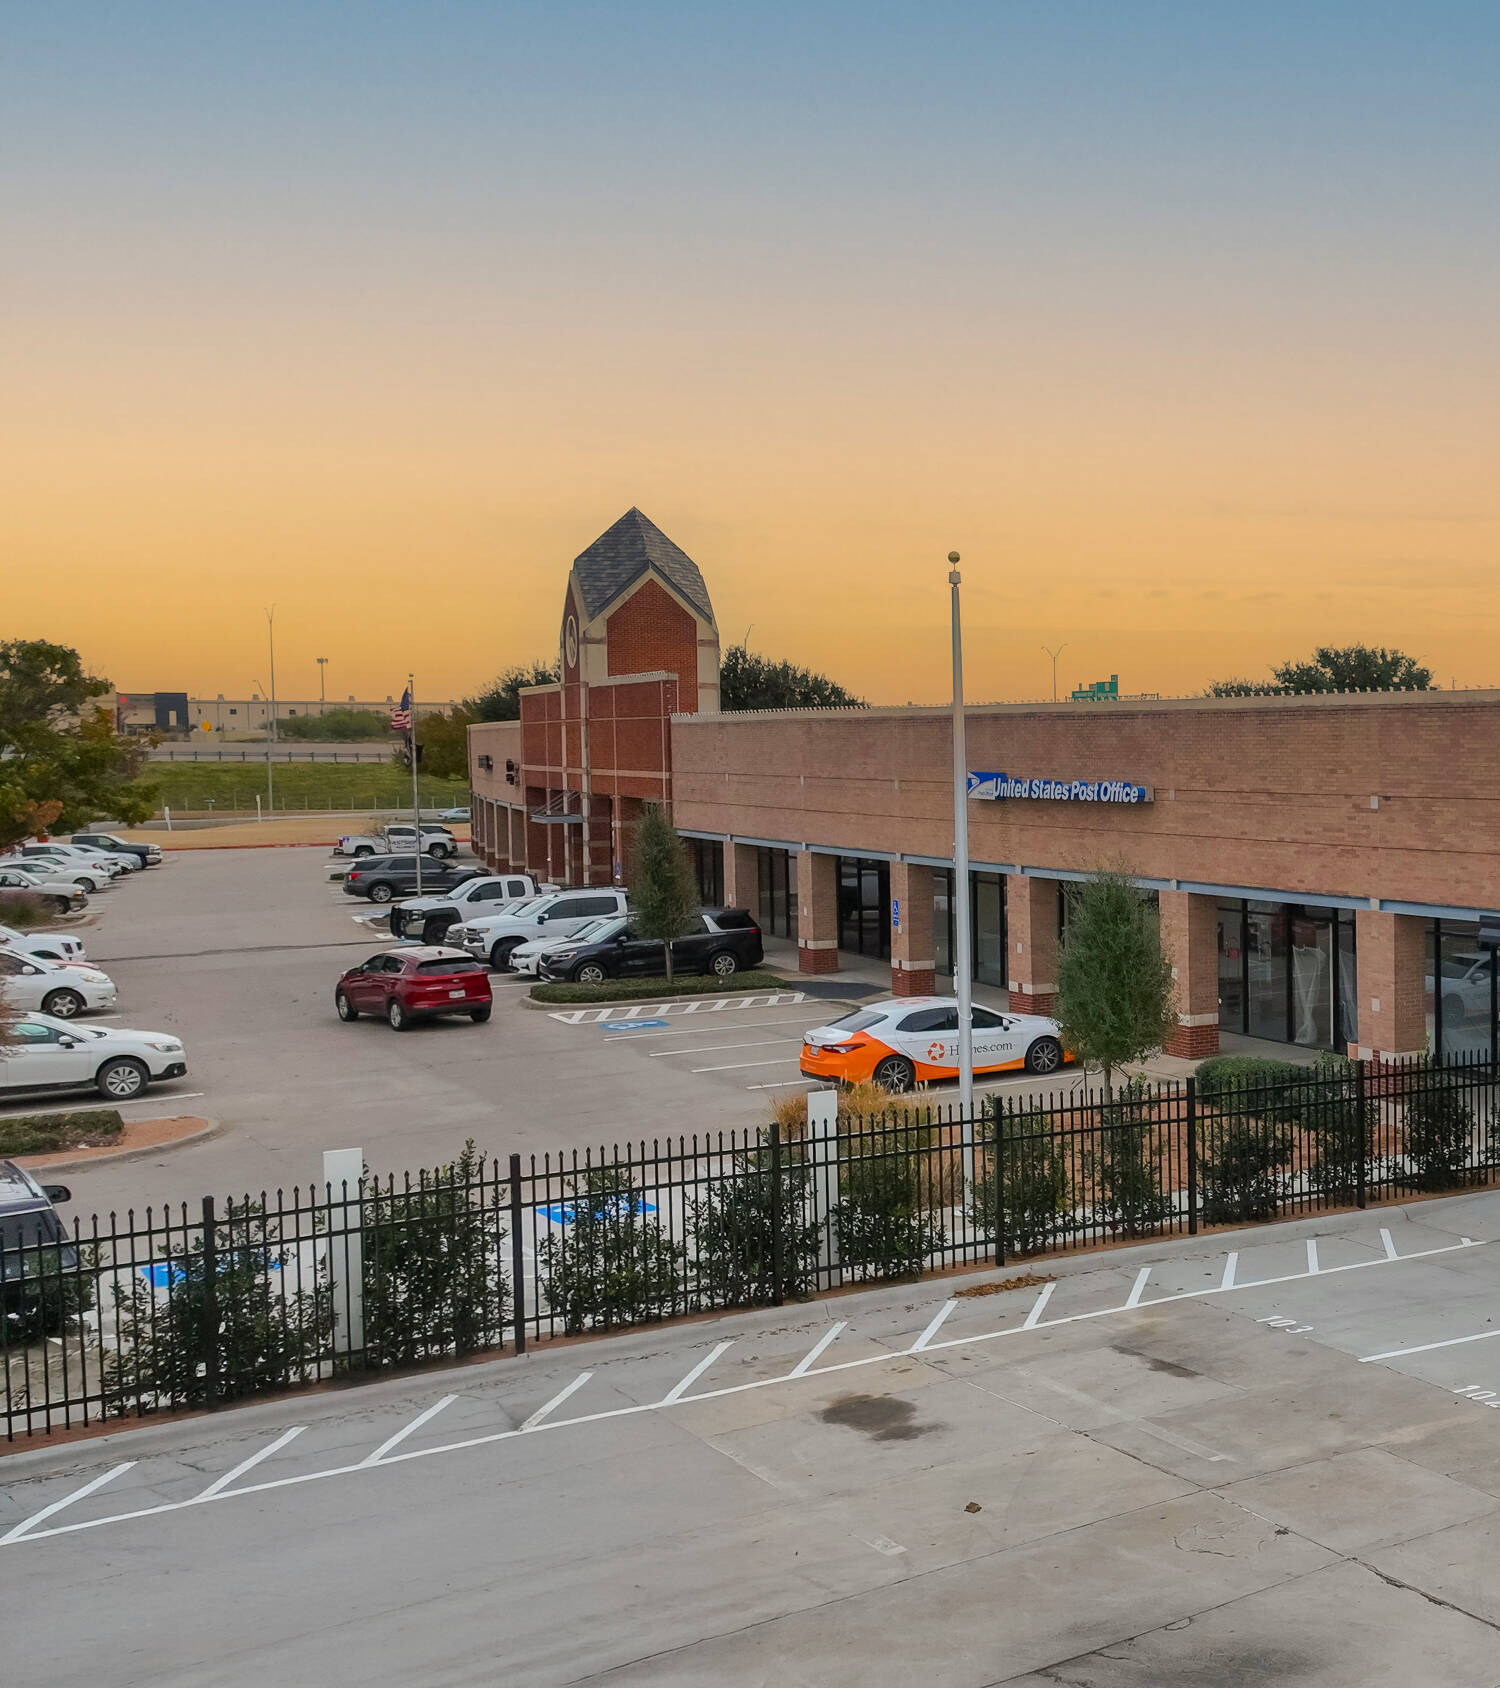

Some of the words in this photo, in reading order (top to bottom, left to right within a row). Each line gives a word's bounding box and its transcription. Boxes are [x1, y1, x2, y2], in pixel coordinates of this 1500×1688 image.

[993, 777, 1029, 798] United
[1031, 779, 1069, 800] States
[1071, 781, 1098, 801] Post
[1100, 781, 1139, 803] Office
[950, 1042, 1013, 1056] Hes.com
[1255, 1315, 1314, 1334] 103
